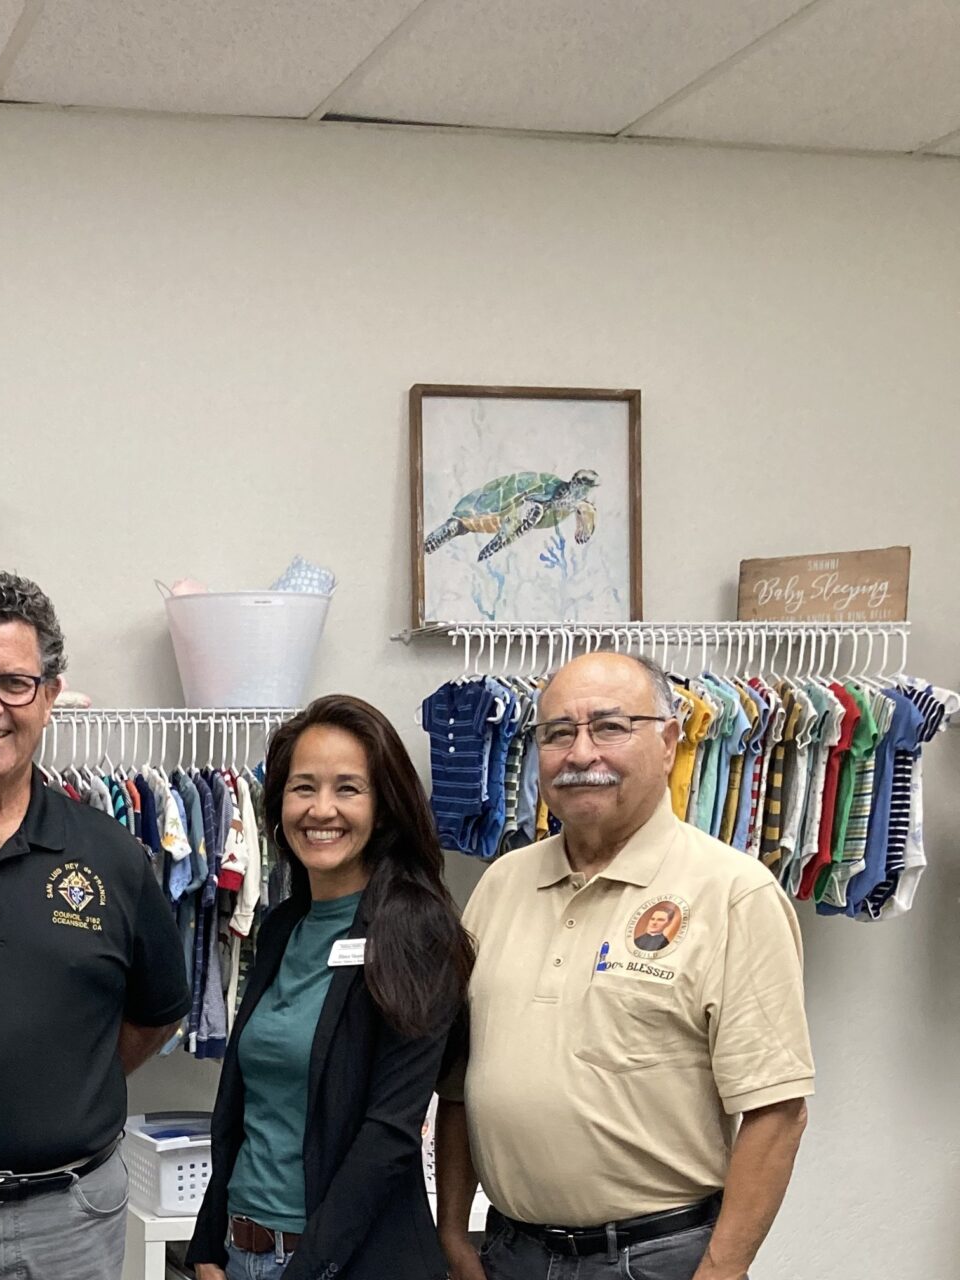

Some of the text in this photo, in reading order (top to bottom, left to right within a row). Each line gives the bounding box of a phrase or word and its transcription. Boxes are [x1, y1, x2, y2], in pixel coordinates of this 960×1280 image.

[753, 572, 891, 613] Baby Sleeping
[53, 910, 81, 921] COUNCIL
[626, 961, 674, 980] BLESSED
